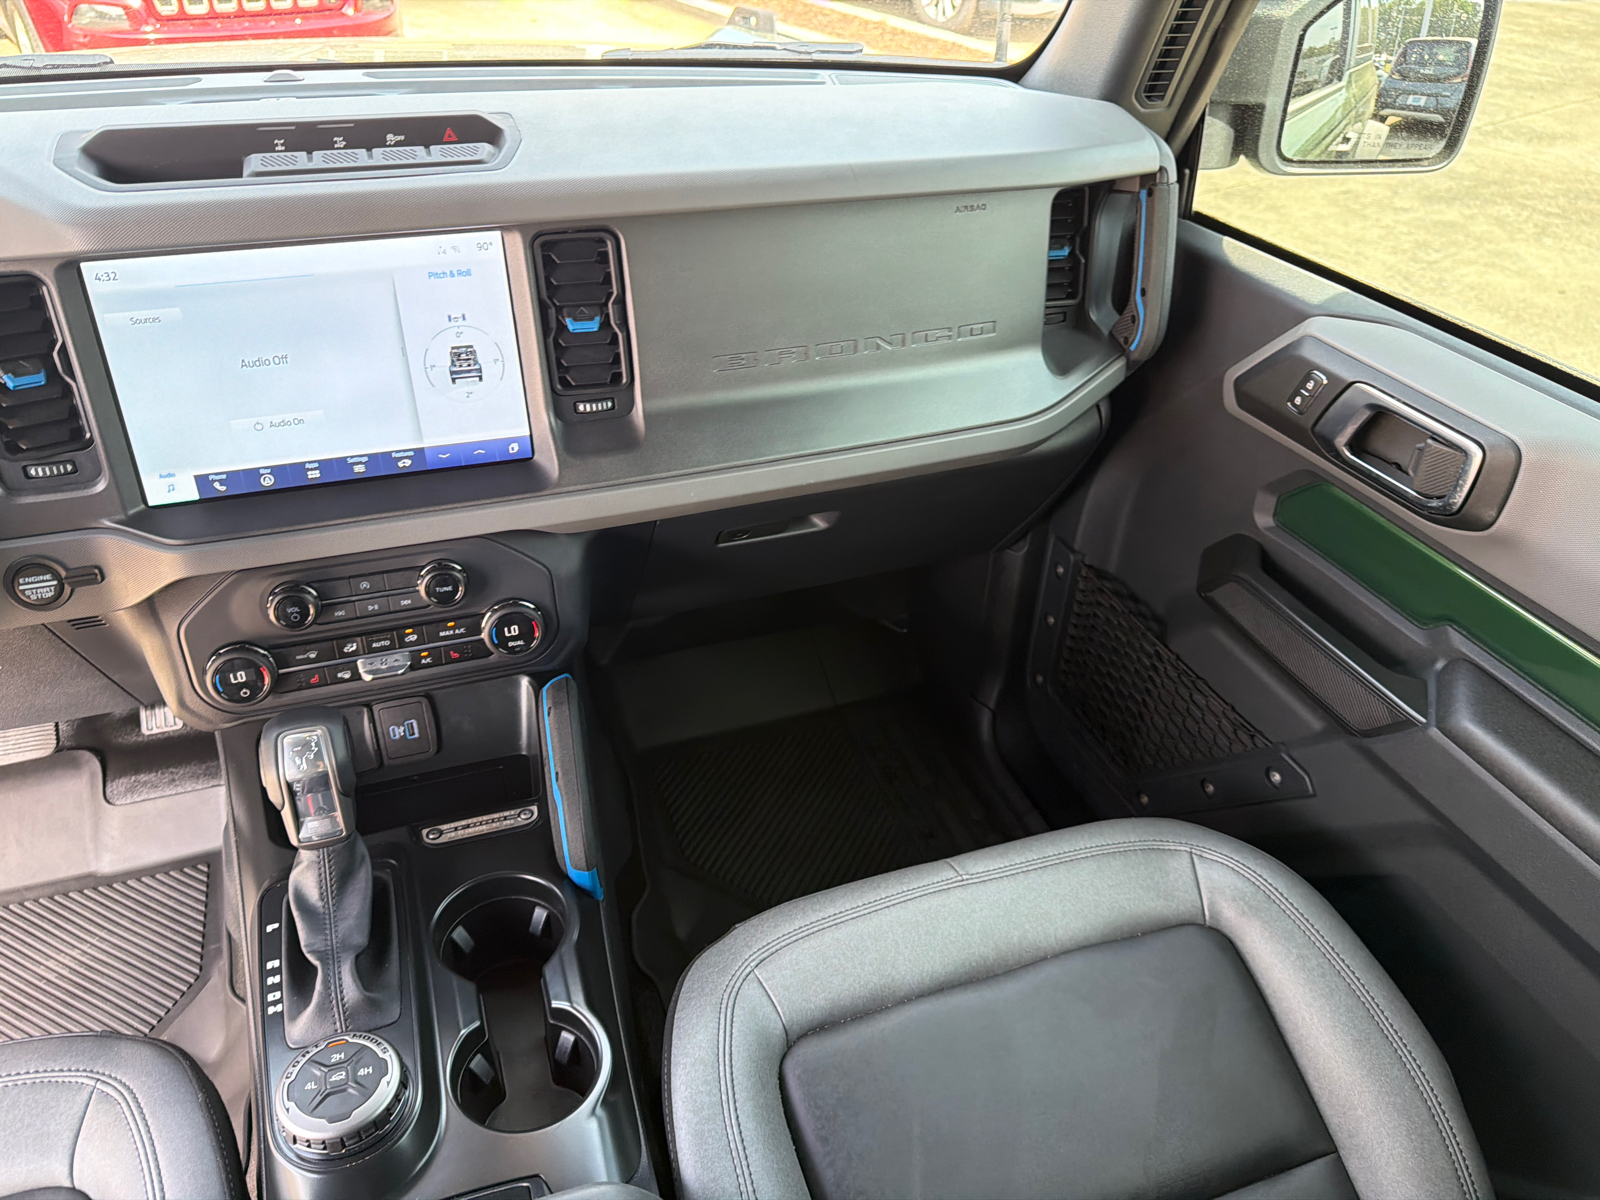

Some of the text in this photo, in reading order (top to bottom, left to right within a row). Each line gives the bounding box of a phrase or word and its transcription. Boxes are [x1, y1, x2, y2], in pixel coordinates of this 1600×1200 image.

[954, 204, 987, 213] AIRBAG
[94, 271, 118, 282] 4:32
[428, 269, 472, 279] Pitch & Roll
[130, 315, 161, 325] Sources
[712, 320, 996, 372] BRONCO
[240, 354, 289, 370] Audio Off
[269, 417, 305, 429] Audio On
[19, 573, 53, 584] ENGINE
[25, 586, 56, 596] START
[30, 591, 55, 600] STOP
[439, 629, 453, 637] MAX
[372, 640, 390, 648] AUTO
[266, 922, 280, 933] P
[266, 974, 280, 986] N
[267, 991, 281, 1002] D
[268, 1003, 282, 1015] M
[352, 1033, 390, 1055] MODES
[330, 1052, 345, 1062] 2H
[358, 1066, 373, 1076] 4H
[304, 1081, 318, 1090] 4L
